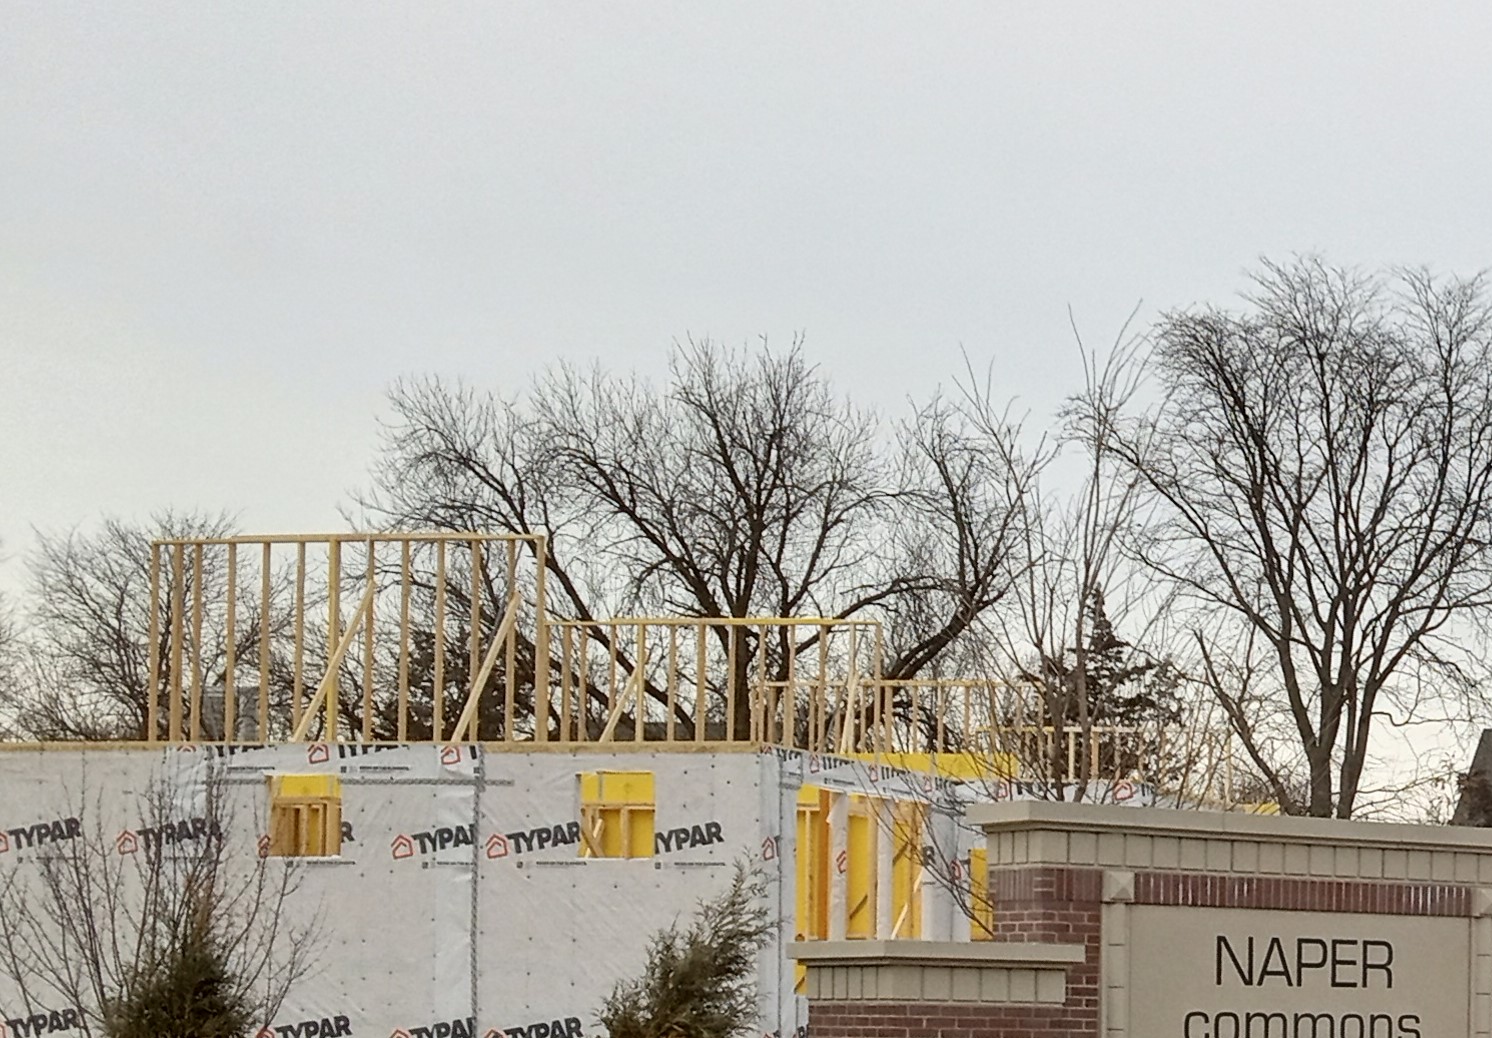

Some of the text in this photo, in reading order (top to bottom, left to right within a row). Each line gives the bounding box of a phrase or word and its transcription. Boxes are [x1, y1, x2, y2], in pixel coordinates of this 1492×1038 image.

[8, 817, 82, 850] TYPAR
[1215, 935, 1394, 989] NAPER
[6, 1008, 80, 1038] TYPAR
